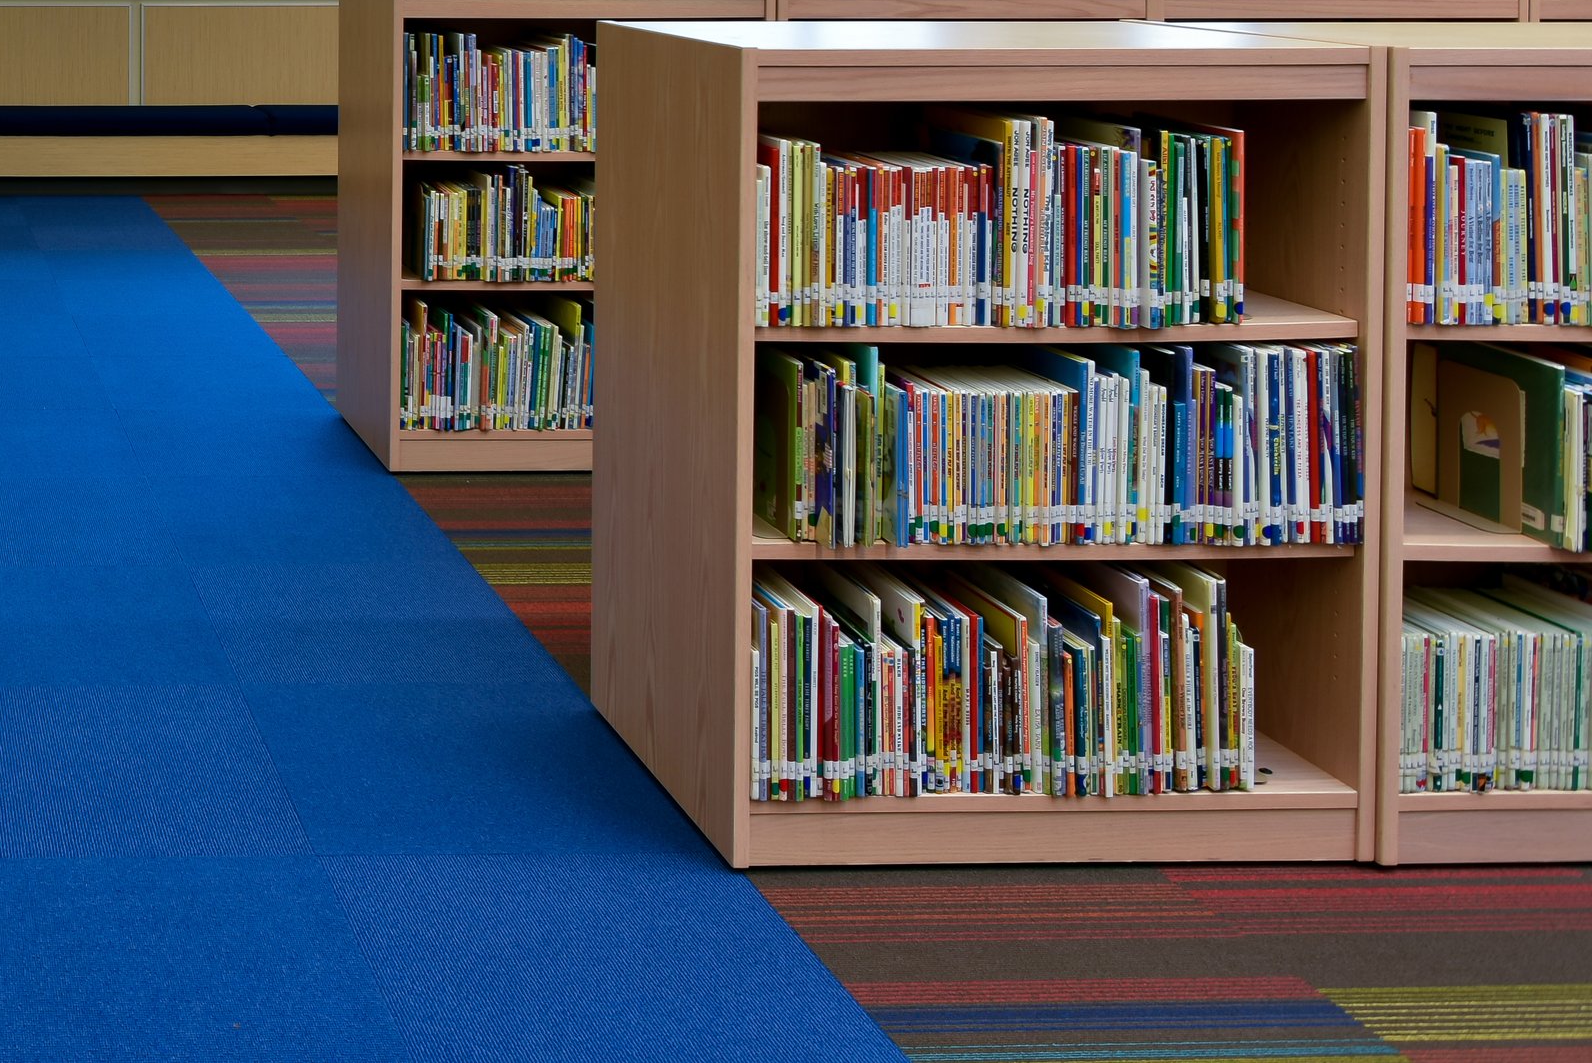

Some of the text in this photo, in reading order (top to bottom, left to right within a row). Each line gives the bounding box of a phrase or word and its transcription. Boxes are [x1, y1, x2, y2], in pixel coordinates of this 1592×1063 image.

[1011, 187, 1019, 254] NOTHING
[1115, 682, 1123, 745] SHARK TRAIN
